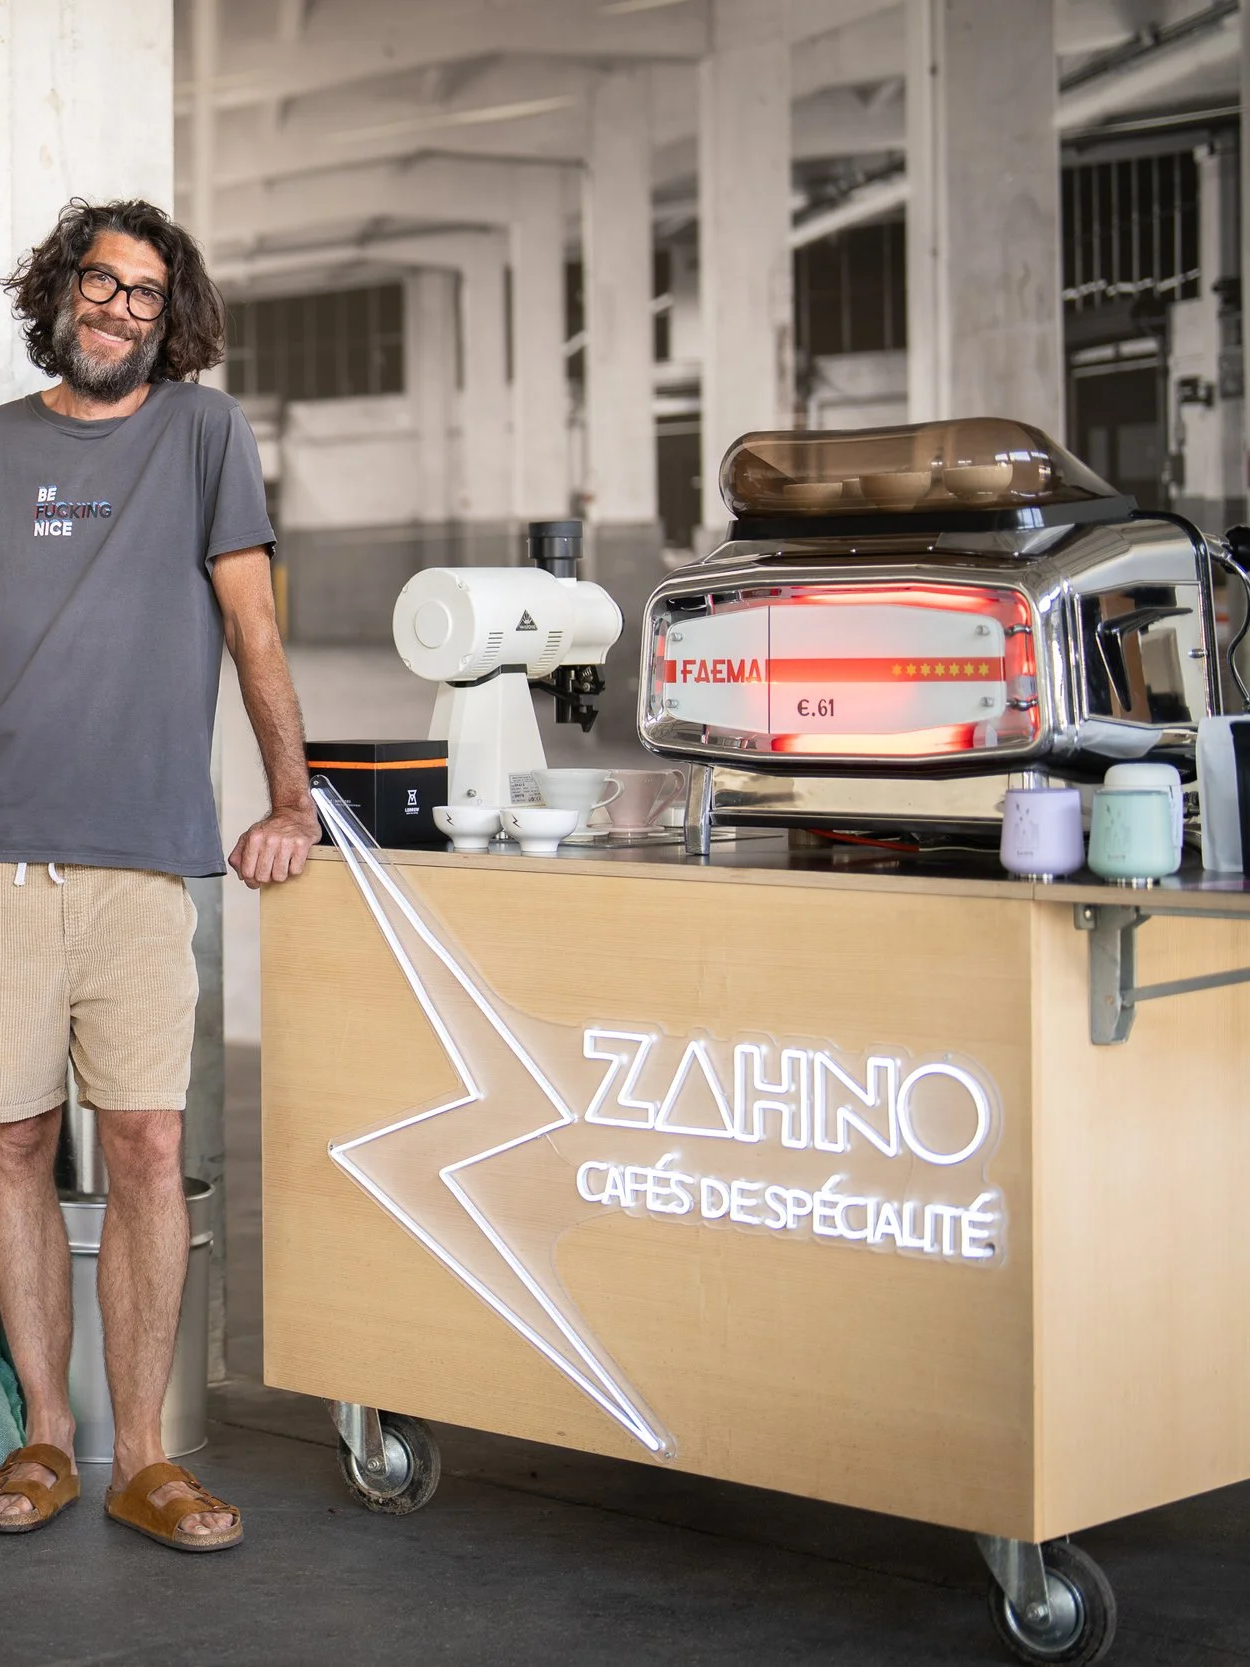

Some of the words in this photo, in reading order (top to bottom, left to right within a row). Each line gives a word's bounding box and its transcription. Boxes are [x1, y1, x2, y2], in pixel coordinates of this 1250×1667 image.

[37, 486, 57, 502] BE
[34, 502, 112, 519] FUCKING
[34, 520, 73, 537] NICE
[680, 659, 762, 684] FAEMA
[582, 1028, 990, 1166] ZAHNO
[576, 1152, 694, 1215] CAFÉS
[700, 1177, 765, 1225] DE
[764, 1174, 996, 1258] SPÉCIALITÉ
